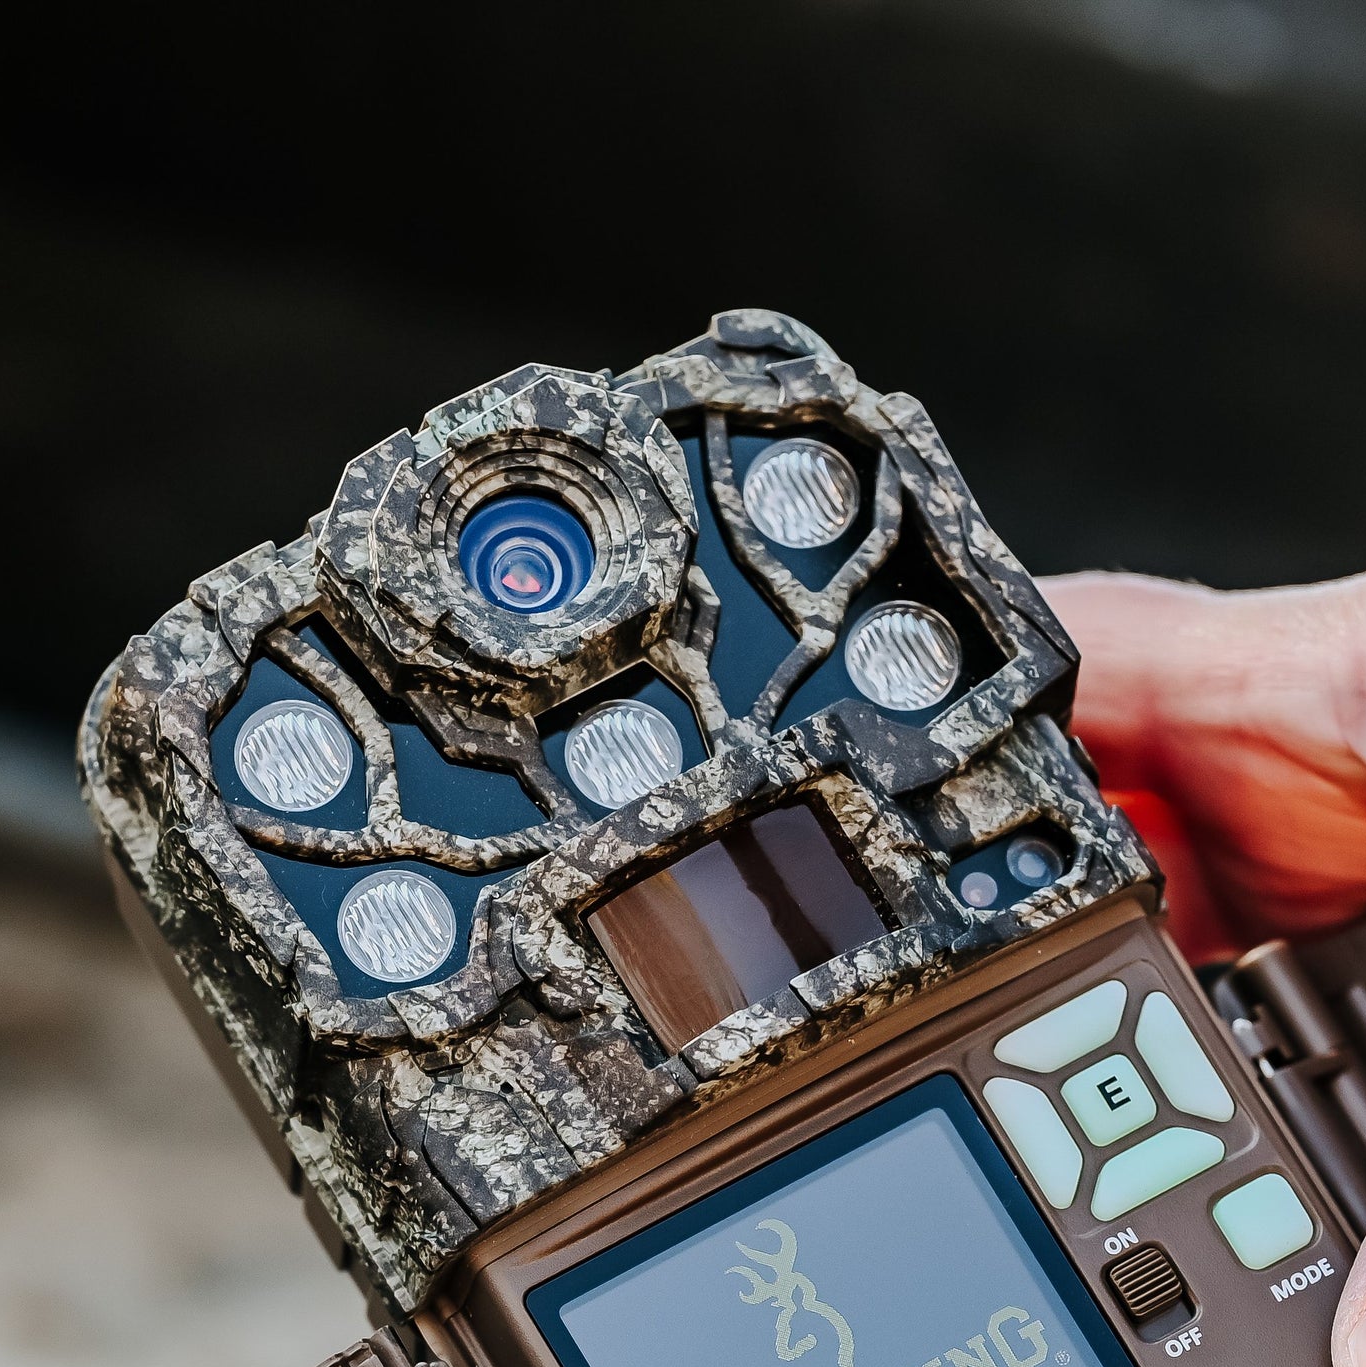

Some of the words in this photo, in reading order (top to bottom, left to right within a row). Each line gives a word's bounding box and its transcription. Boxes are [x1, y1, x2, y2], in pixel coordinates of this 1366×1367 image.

[1096, 1076, 1131, 1111] E
[1103, 1227, 1140, 1256] ON
[1269, 1257, 1335, 1303] MODE
[1164, 1327, 1203, 1358] OFF
